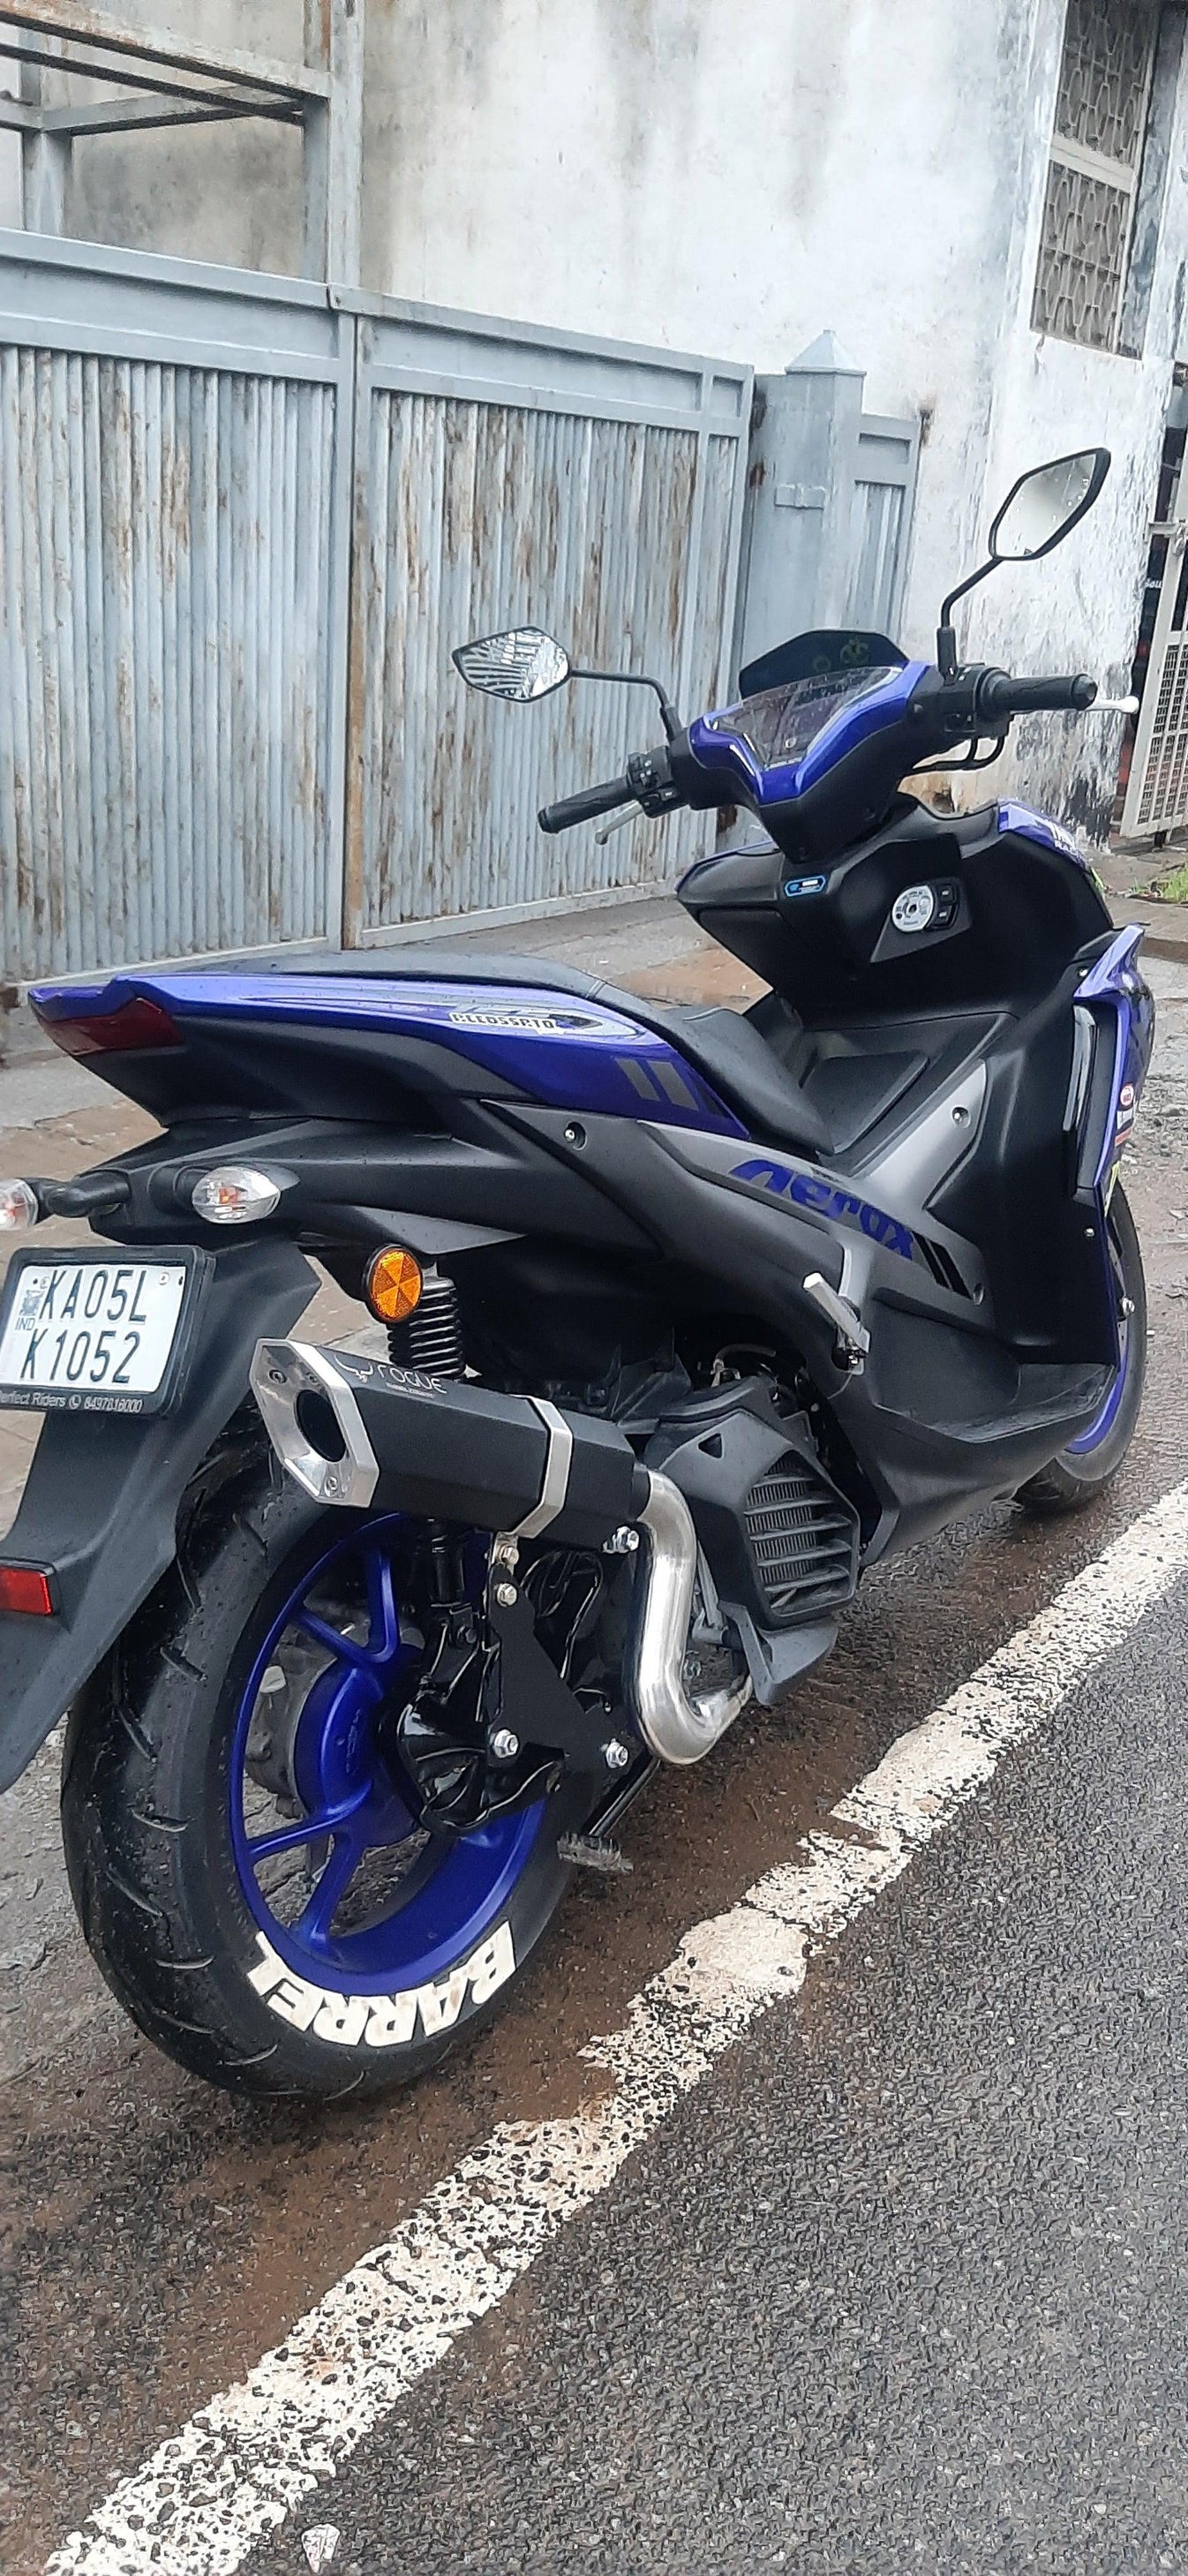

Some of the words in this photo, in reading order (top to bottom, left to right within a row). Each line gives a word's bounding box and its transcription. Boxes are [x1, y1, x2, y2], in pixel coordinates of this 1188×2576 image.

[39, 1269, 147, 1322] KA05L
[15, 1317, 36, 1331] IND
[20, 1329, 140, 1383] K1052
[246, 1920, 516, 2047] BARREL
